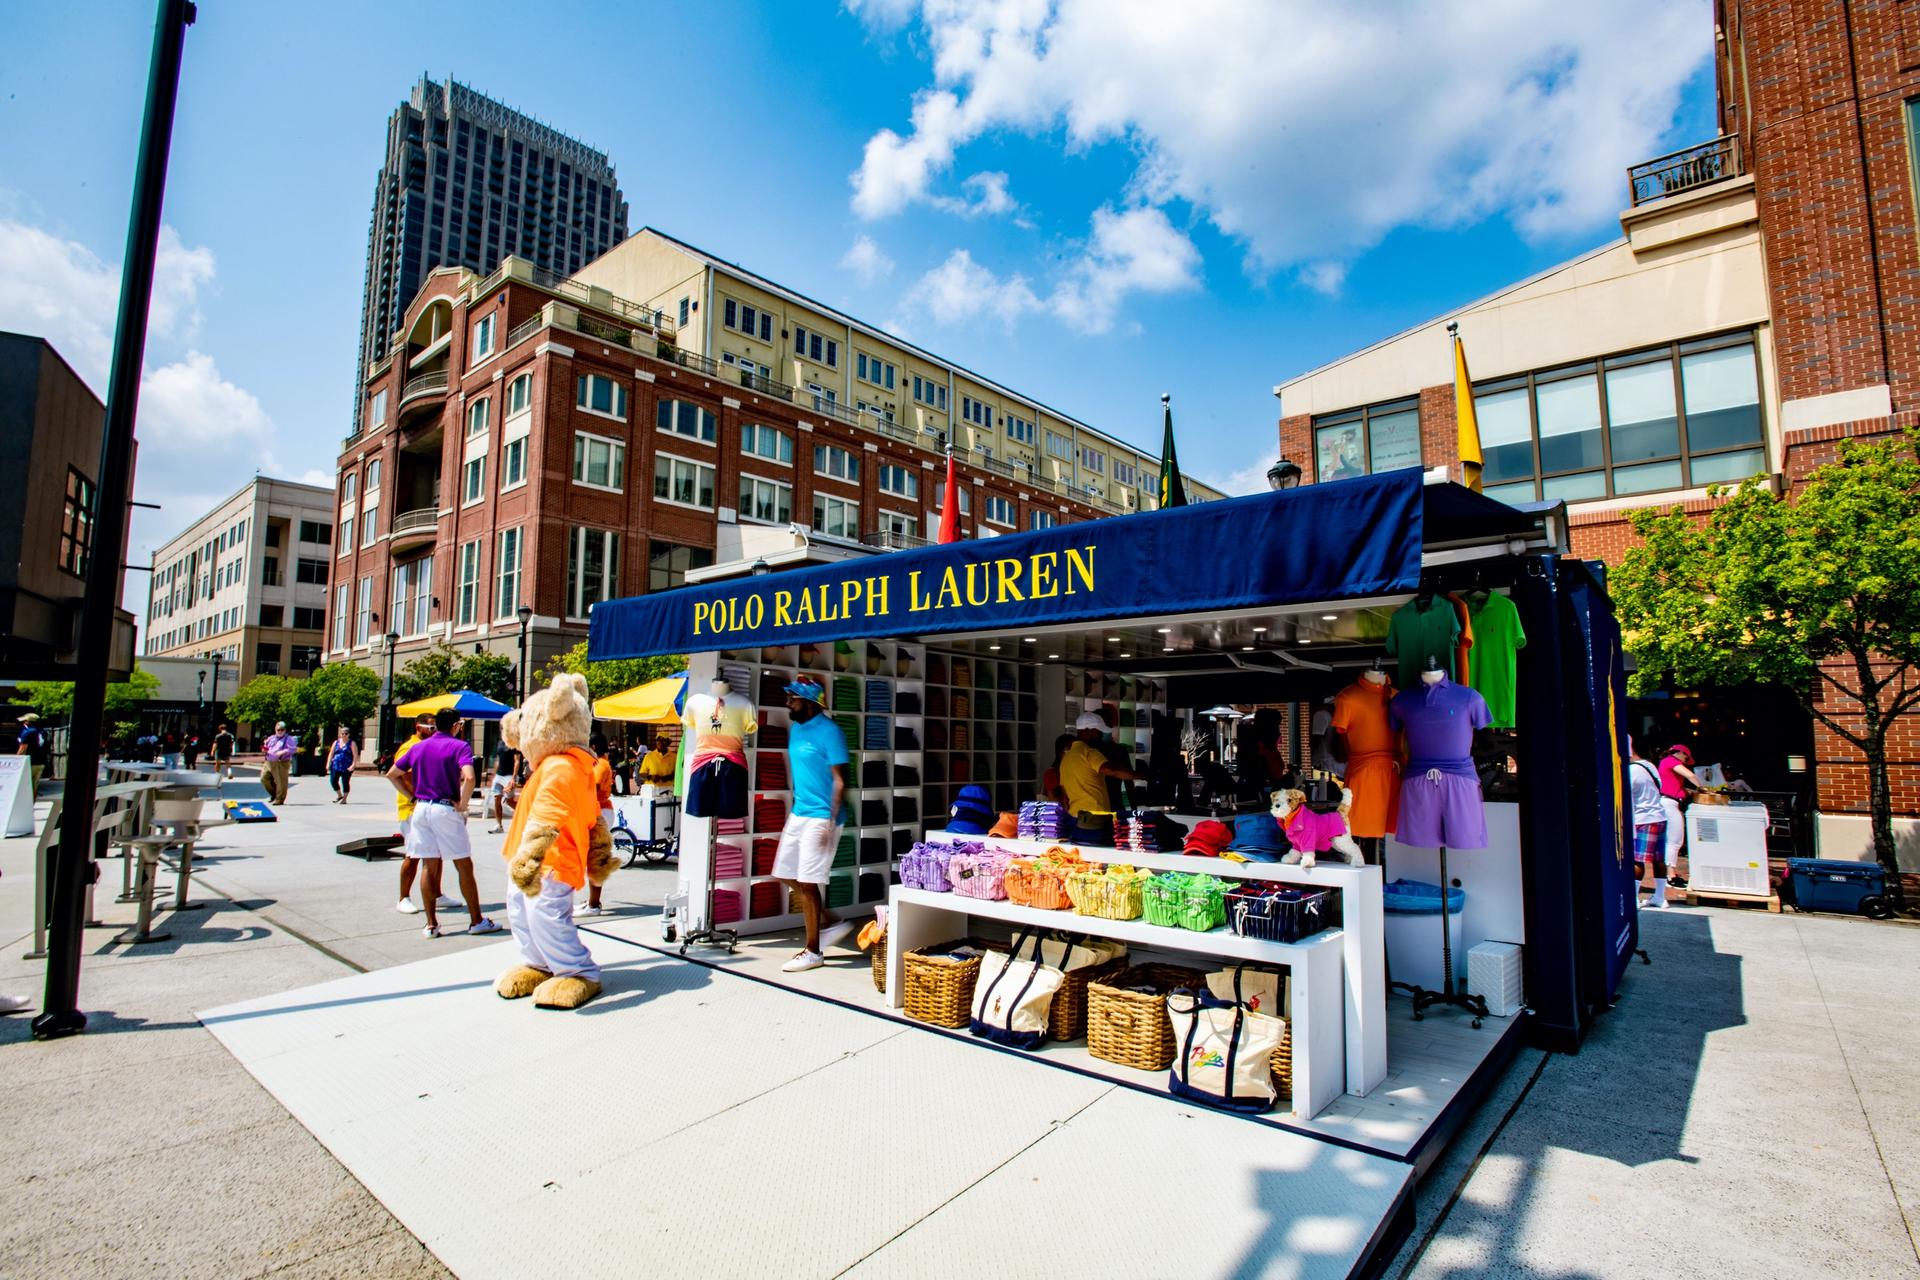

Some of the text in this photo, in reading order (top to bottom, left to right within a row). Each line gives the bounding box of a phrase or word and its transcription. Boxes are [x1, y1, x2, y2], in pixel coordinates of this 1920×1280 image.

[693, 545, 1097, 635] POLO RALPH LAUREN
[1190, 1046, 1225, 1067] Polo
